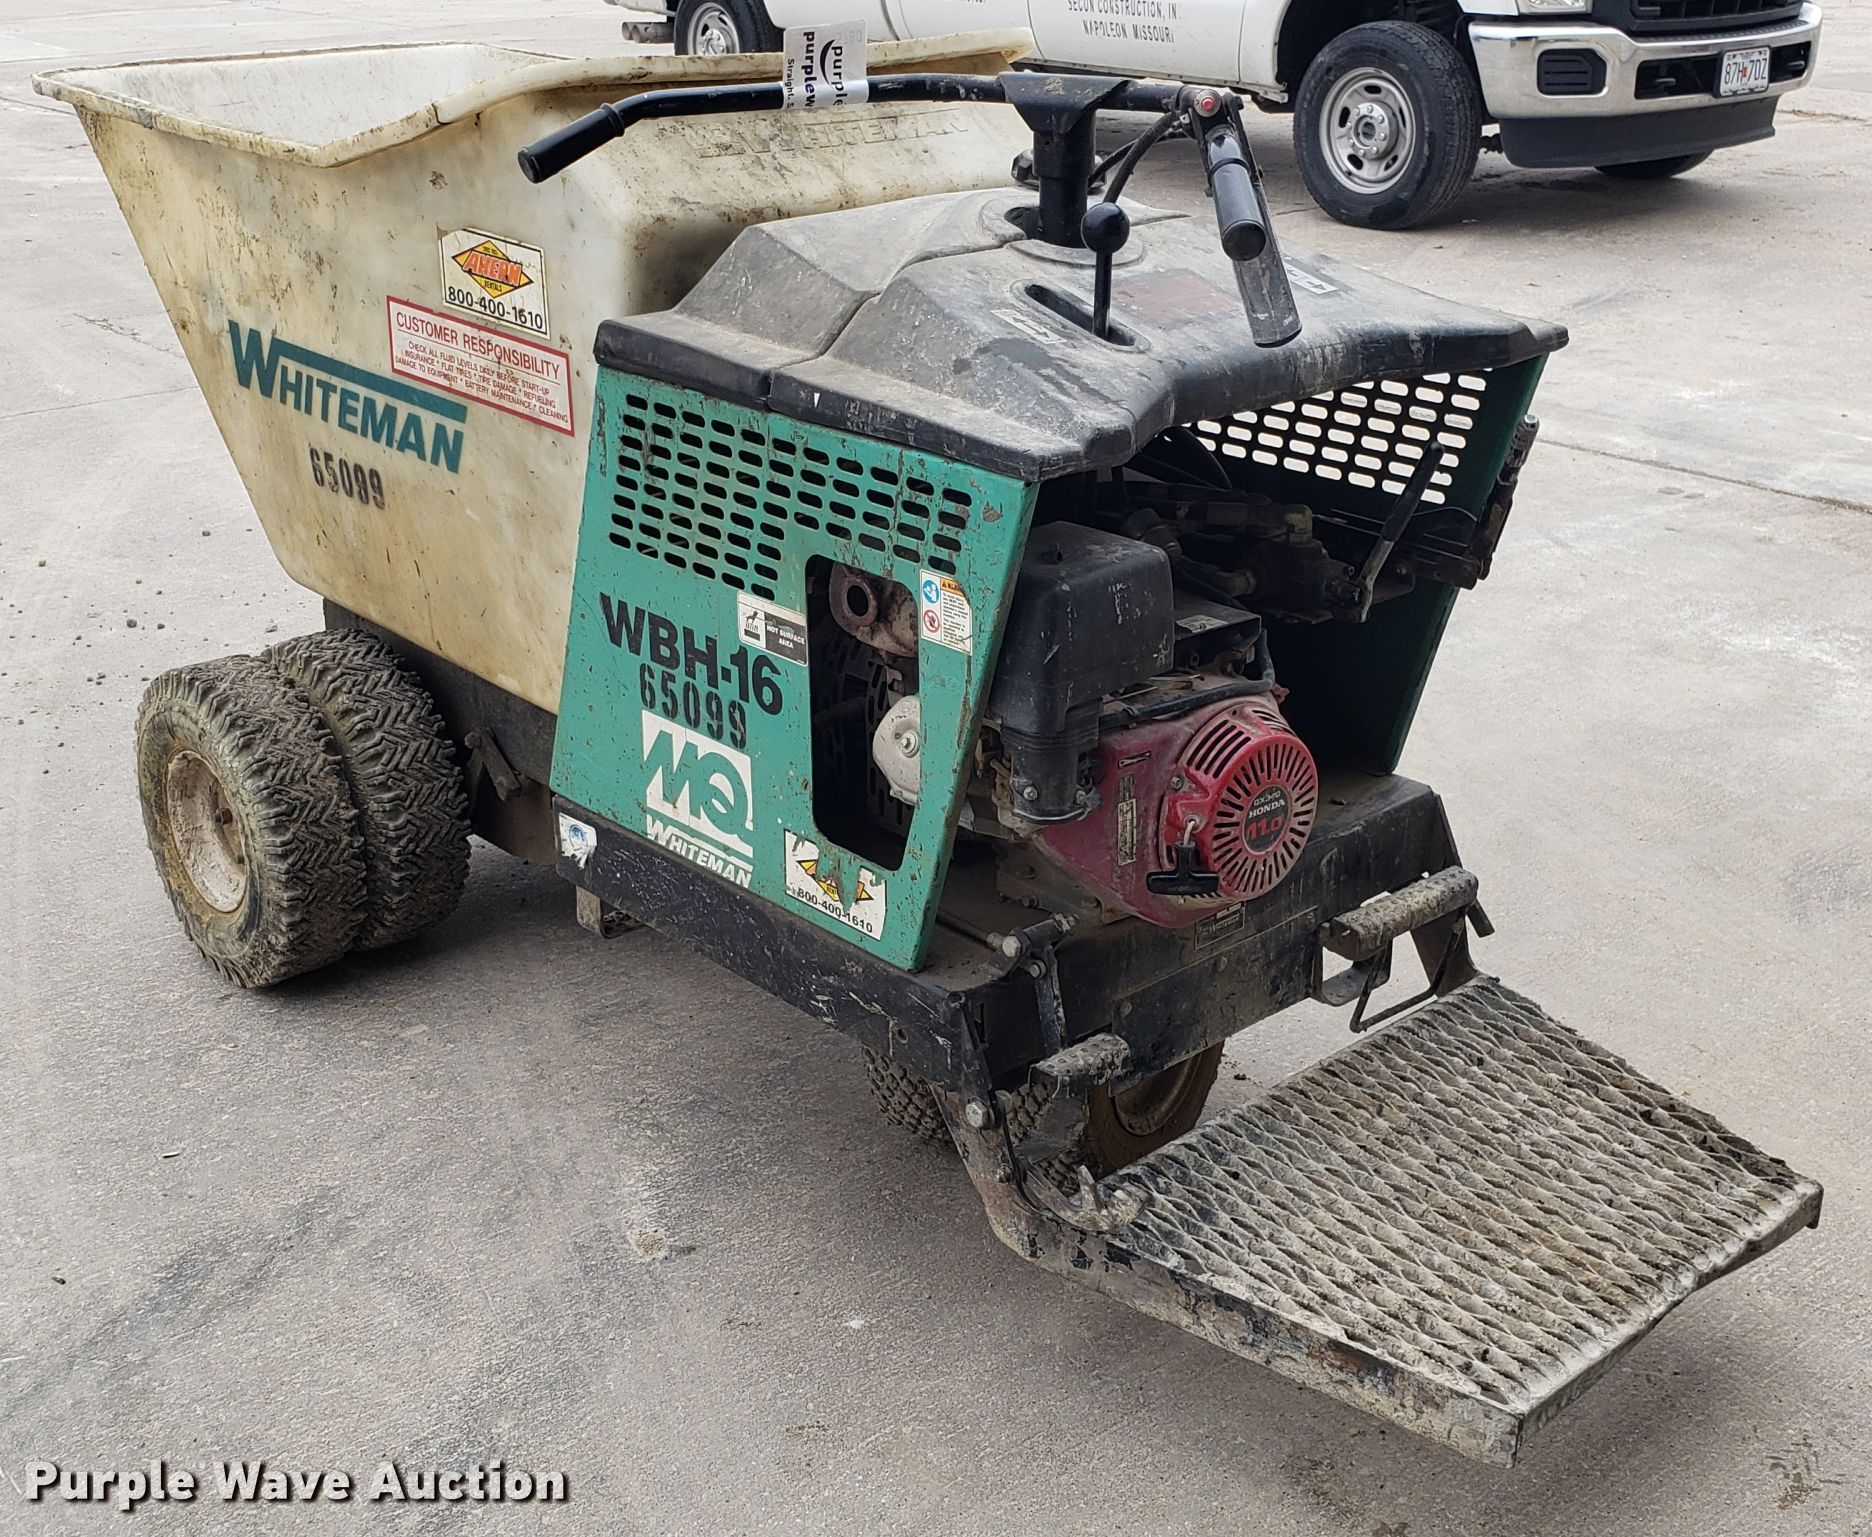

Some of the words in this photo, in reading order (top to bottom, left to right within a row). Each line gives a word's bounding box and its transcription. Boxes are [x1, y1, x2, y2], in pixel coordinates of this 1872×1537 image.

[1083, 19, 1128, 39] NAPOLEON
[1132, 24, 1175, 43] MISSOURI
[785, 58, 794, 100] Straight.
[448, 286, 543, 329] 800-400-1610
[396, 312, 459, 346] CUSTOMER
[463, 333, 560, 380] RESPONSIBILITY
[408, 341, 427, 354] CHECK
[429, 348, 438, 359] ALL
[440, 352, 456, 364] FLUID
[457, 358, 478, 372] LEVELS
[497, 371, 520, 386] BEFORE
[522, 380, 550, 396] START-UP
[228, 319, 467, 474] WHITEMAN
[395, 356, 417, 370] DAMAGE
[419, 363, 425, 373] TO
[427, 367, 459, 384] EQUIPMENT
[465, 380, 489, 395] BATTERY
[491, 389, 532, 410] MAINTENANCE
[538, 405, 569, 424] CLEANING
[405, 350, 435, 367] INSURANCE
[441, 362, 454, 373] FLAT
[456, 367, 472, 380] TIRES
[493, 380, 518, 395] DAMAGE
[524, 390, 557, 409] REFUELING
[309, 447, 386, 510] 65099
[599, 591, 784, 716] WBH-16
[766, 624, 779, 635] HOT
[639, 662, 748, 750] 65099
[1248, 798, 1286, 819] HONDA
[1248, 815, 1283, 840] 11.0
[646, 814, 753, 889] WHITEMAN
[798, 888, 873, 933] 800-400-1610
